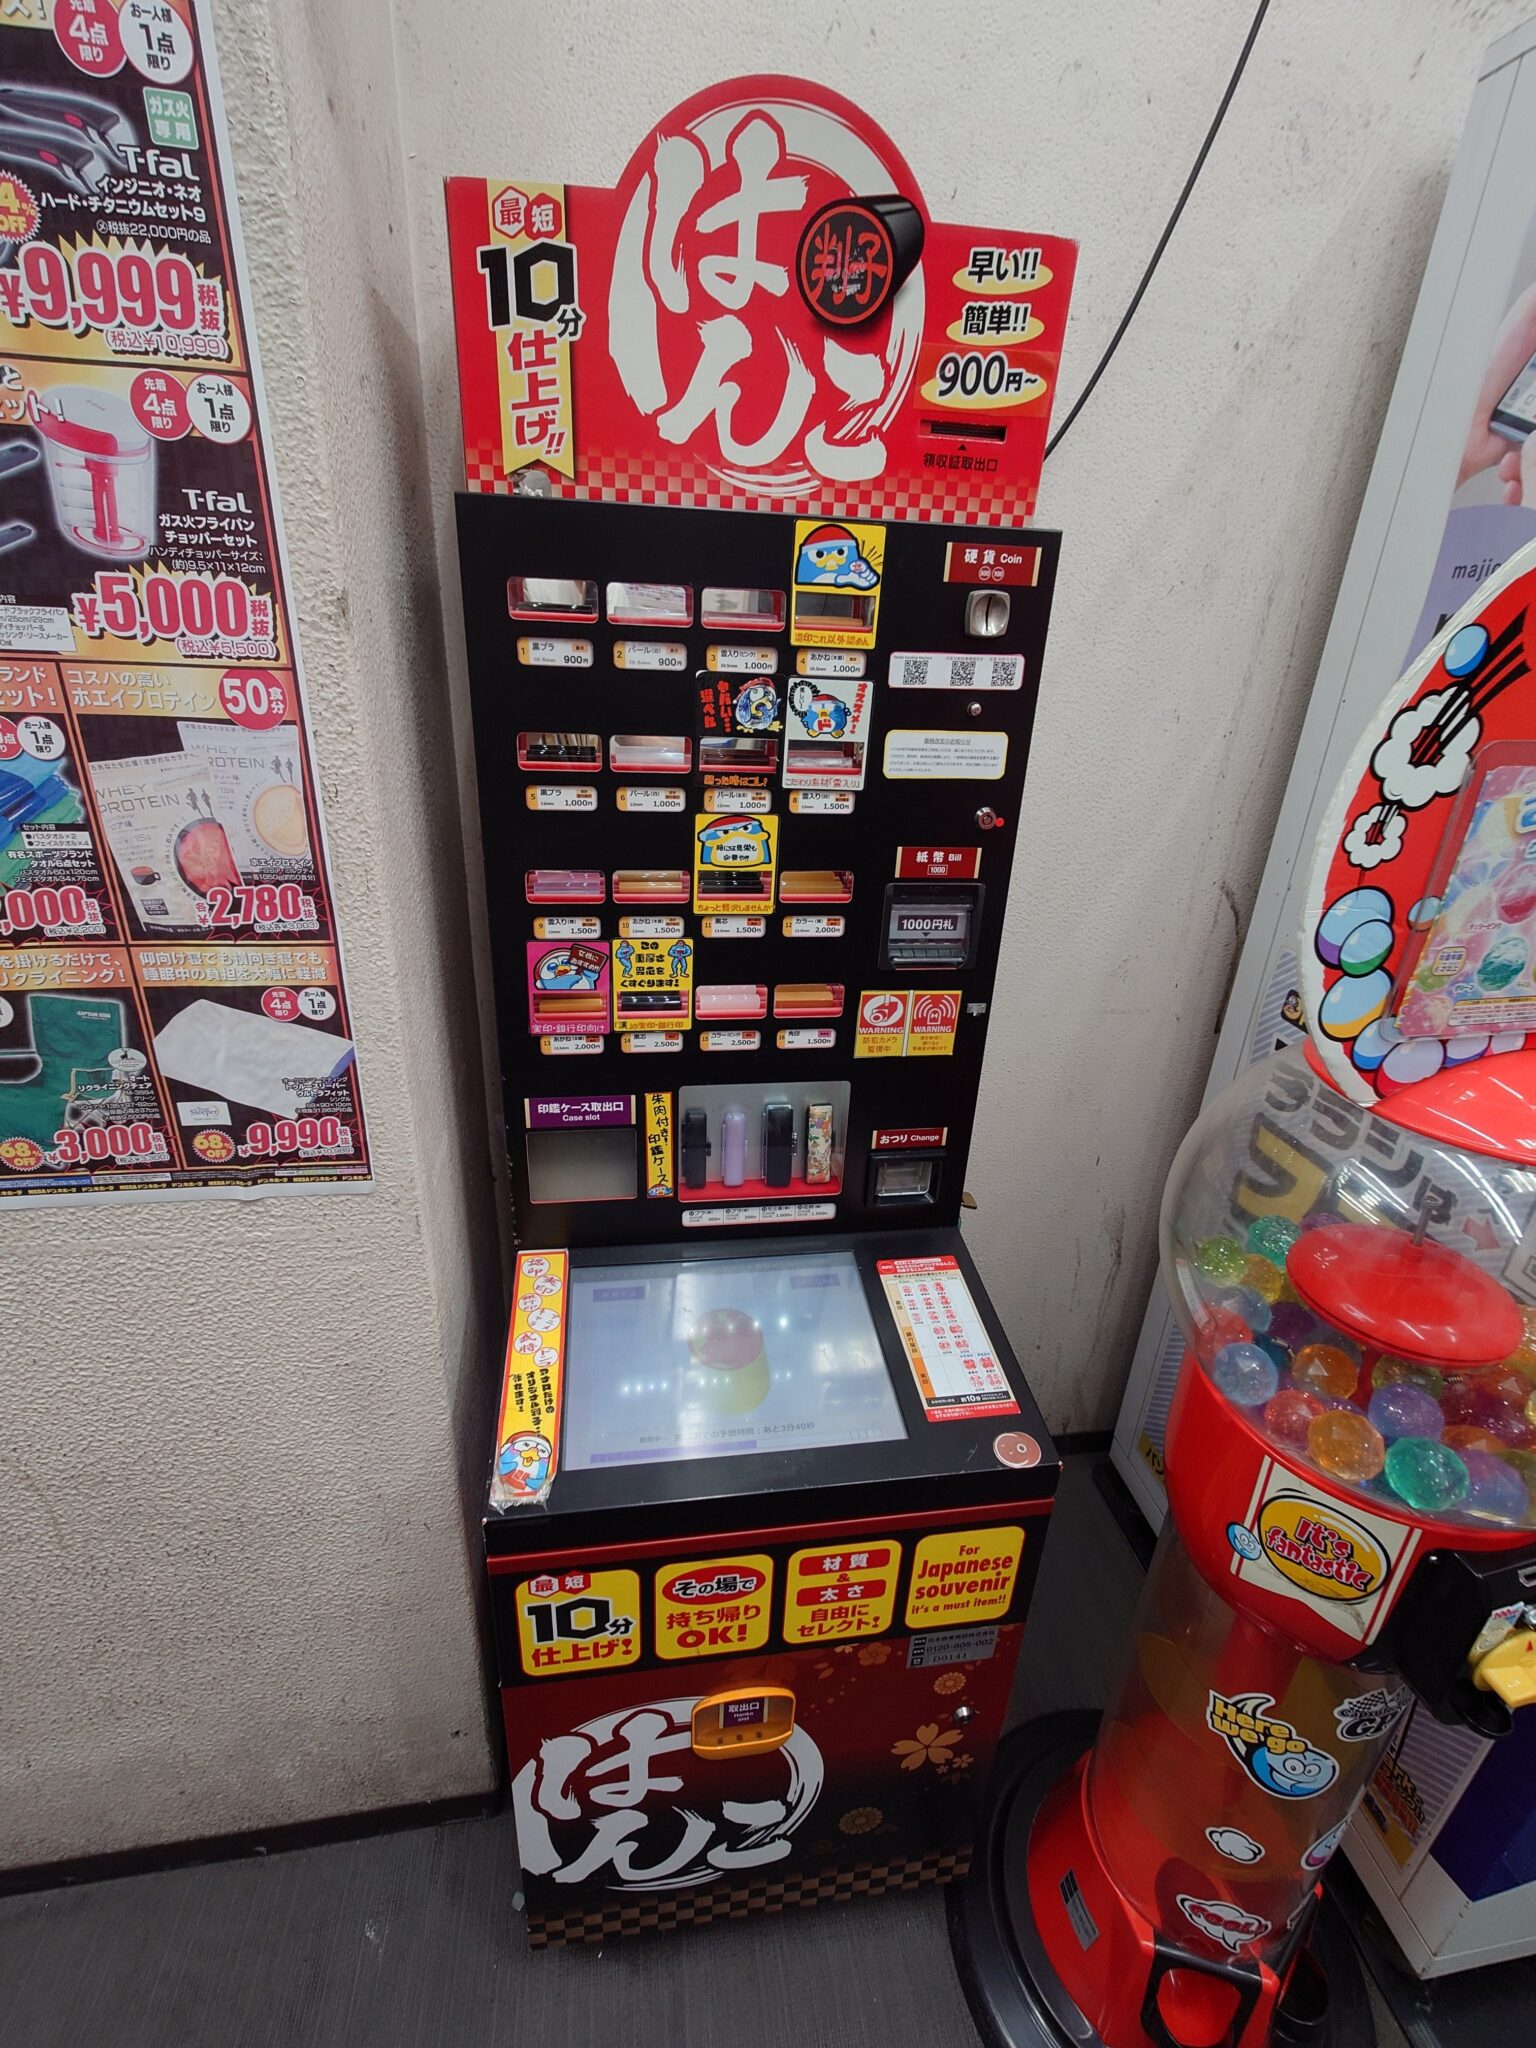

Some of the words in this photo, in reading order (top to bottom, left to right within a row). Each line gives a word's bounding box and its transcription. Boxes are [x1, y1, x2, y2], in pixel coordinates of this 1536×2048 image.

[130, 3, 173, 23] お一人様
[69, 15, 109, 46] 4点
[139, 24, 175, 54] 1点
[78, 44, 104, 62] 限り
[147, 53, 171, 70] 限り
[150, 96, 190, 119] ガス火
[155, 119, 191, 141] 専用
[119, 145, 200, 181] T-fal
[98, 178, 202, 203] インジニオ・ネオ
[40, 191, 206, 223] ハード・チタニウムセット9
[492, 188, 558, 238] 最短
[967, 249, 1039, 284] 早い!!
[477, 241, 584, 338] 10分
[199, 284, 221, 331] 税抜
[961, 303, 1029, 335] 簡単!!
[144, 378, 167, 391] 先着
[197, 383, 234, 397] お一人様
[507, 330, 564, 457] 仕上げ!!
[143, 394, 177, 416] 4点
[206, 398, 235, 420] 1点
[152, 416, 173, 429] 限り
[210, 420, 231, 433] 限り
[923, 451, 999, 473] 領収証取出口
[182, 489, 252, 514] T-fal
[158, 514, 255, 532] ガス火フライパン
[165, 531, 257, 547] チョッパーセット
[964, 548, 996, 564] 硬貨
[1000, 553, 1022, 564] Coin
[251, 600, 269, 637] 税抜
[563, 656, 588, 664] 900円
[658, 658, 682, 666] 900円
[744, 662, 772, 670] 1,000円
[833, 665, 860, 673] 1,000円
[72, 687, 216, 714] ホエイプロテイン
[222, 679, 267, 715] 50
[270, 688, 284, 714] 食分
[30, 731, 54, 745] 1点
[36, 745, 52, 753] 限り
[916, 851, 944, 863] 紙幣
[948, 853, 962, 862] Bill
[930, 866, 946, 874] 1000
[210, 885, 301, 928] 2,780
[902, 919, 954, 930] 1000円札
[641, 942, 659, 950] この
[270, 999, 291, 1010] 4点
[309, 999, 326, 1010] 1点
[859, 1026, 904, 1034] WARNING
[862, 1036, 898, 1044] 防犯カメラ
[537, 1101, 624, 1114] 印鑑ケース取出口
[563, 1114, 581, 1122] Case
[582, 1113, 600, 1121] slot
[880, 1133, 907, 1144] おつり
[910, 1133, 939, 1142] Change
[13, 1157, 36, 1167] OFF
[206, 1149, 227, 1158] OFF
[1296, 1517, 1354, 1560] It's
[959, 1544, 981, 1557] For
[1265, 1526, 1374, 1592] fantastic
[823, 1552, 869, 1571] 材質
[917, 1553, 1013, 1581] Japanese
[534, 1575, 585, 1593] 最短
[673, 1574, 755, 1598] その場で
[837, 1573, 851, 1582] &
[914, 1573, 1010, 1599] souvenir
[820, 1584, 865, 1602] 太さ
[667, 1604, 761, 1629] 持ち帰り
[811, 1603, 870, 1623] 自由に
[911, 1604, 929, 1615] it's
[943, 1599, 971, 1611] must
[528, 1598, 633, 1642] 10分
[797, 1616, 880, 1638] セレクト!
[677, 1625, 747, 1648] OK!
[531, 1639, 633, 1667] 仕上げ!
[728, 1702, 760, 1713] 取出口
[1214, 1700, 1292, 1739] Here
[1212, 1714, 1258, 1743] we
[1266, 1733, 1306, 1754] go
